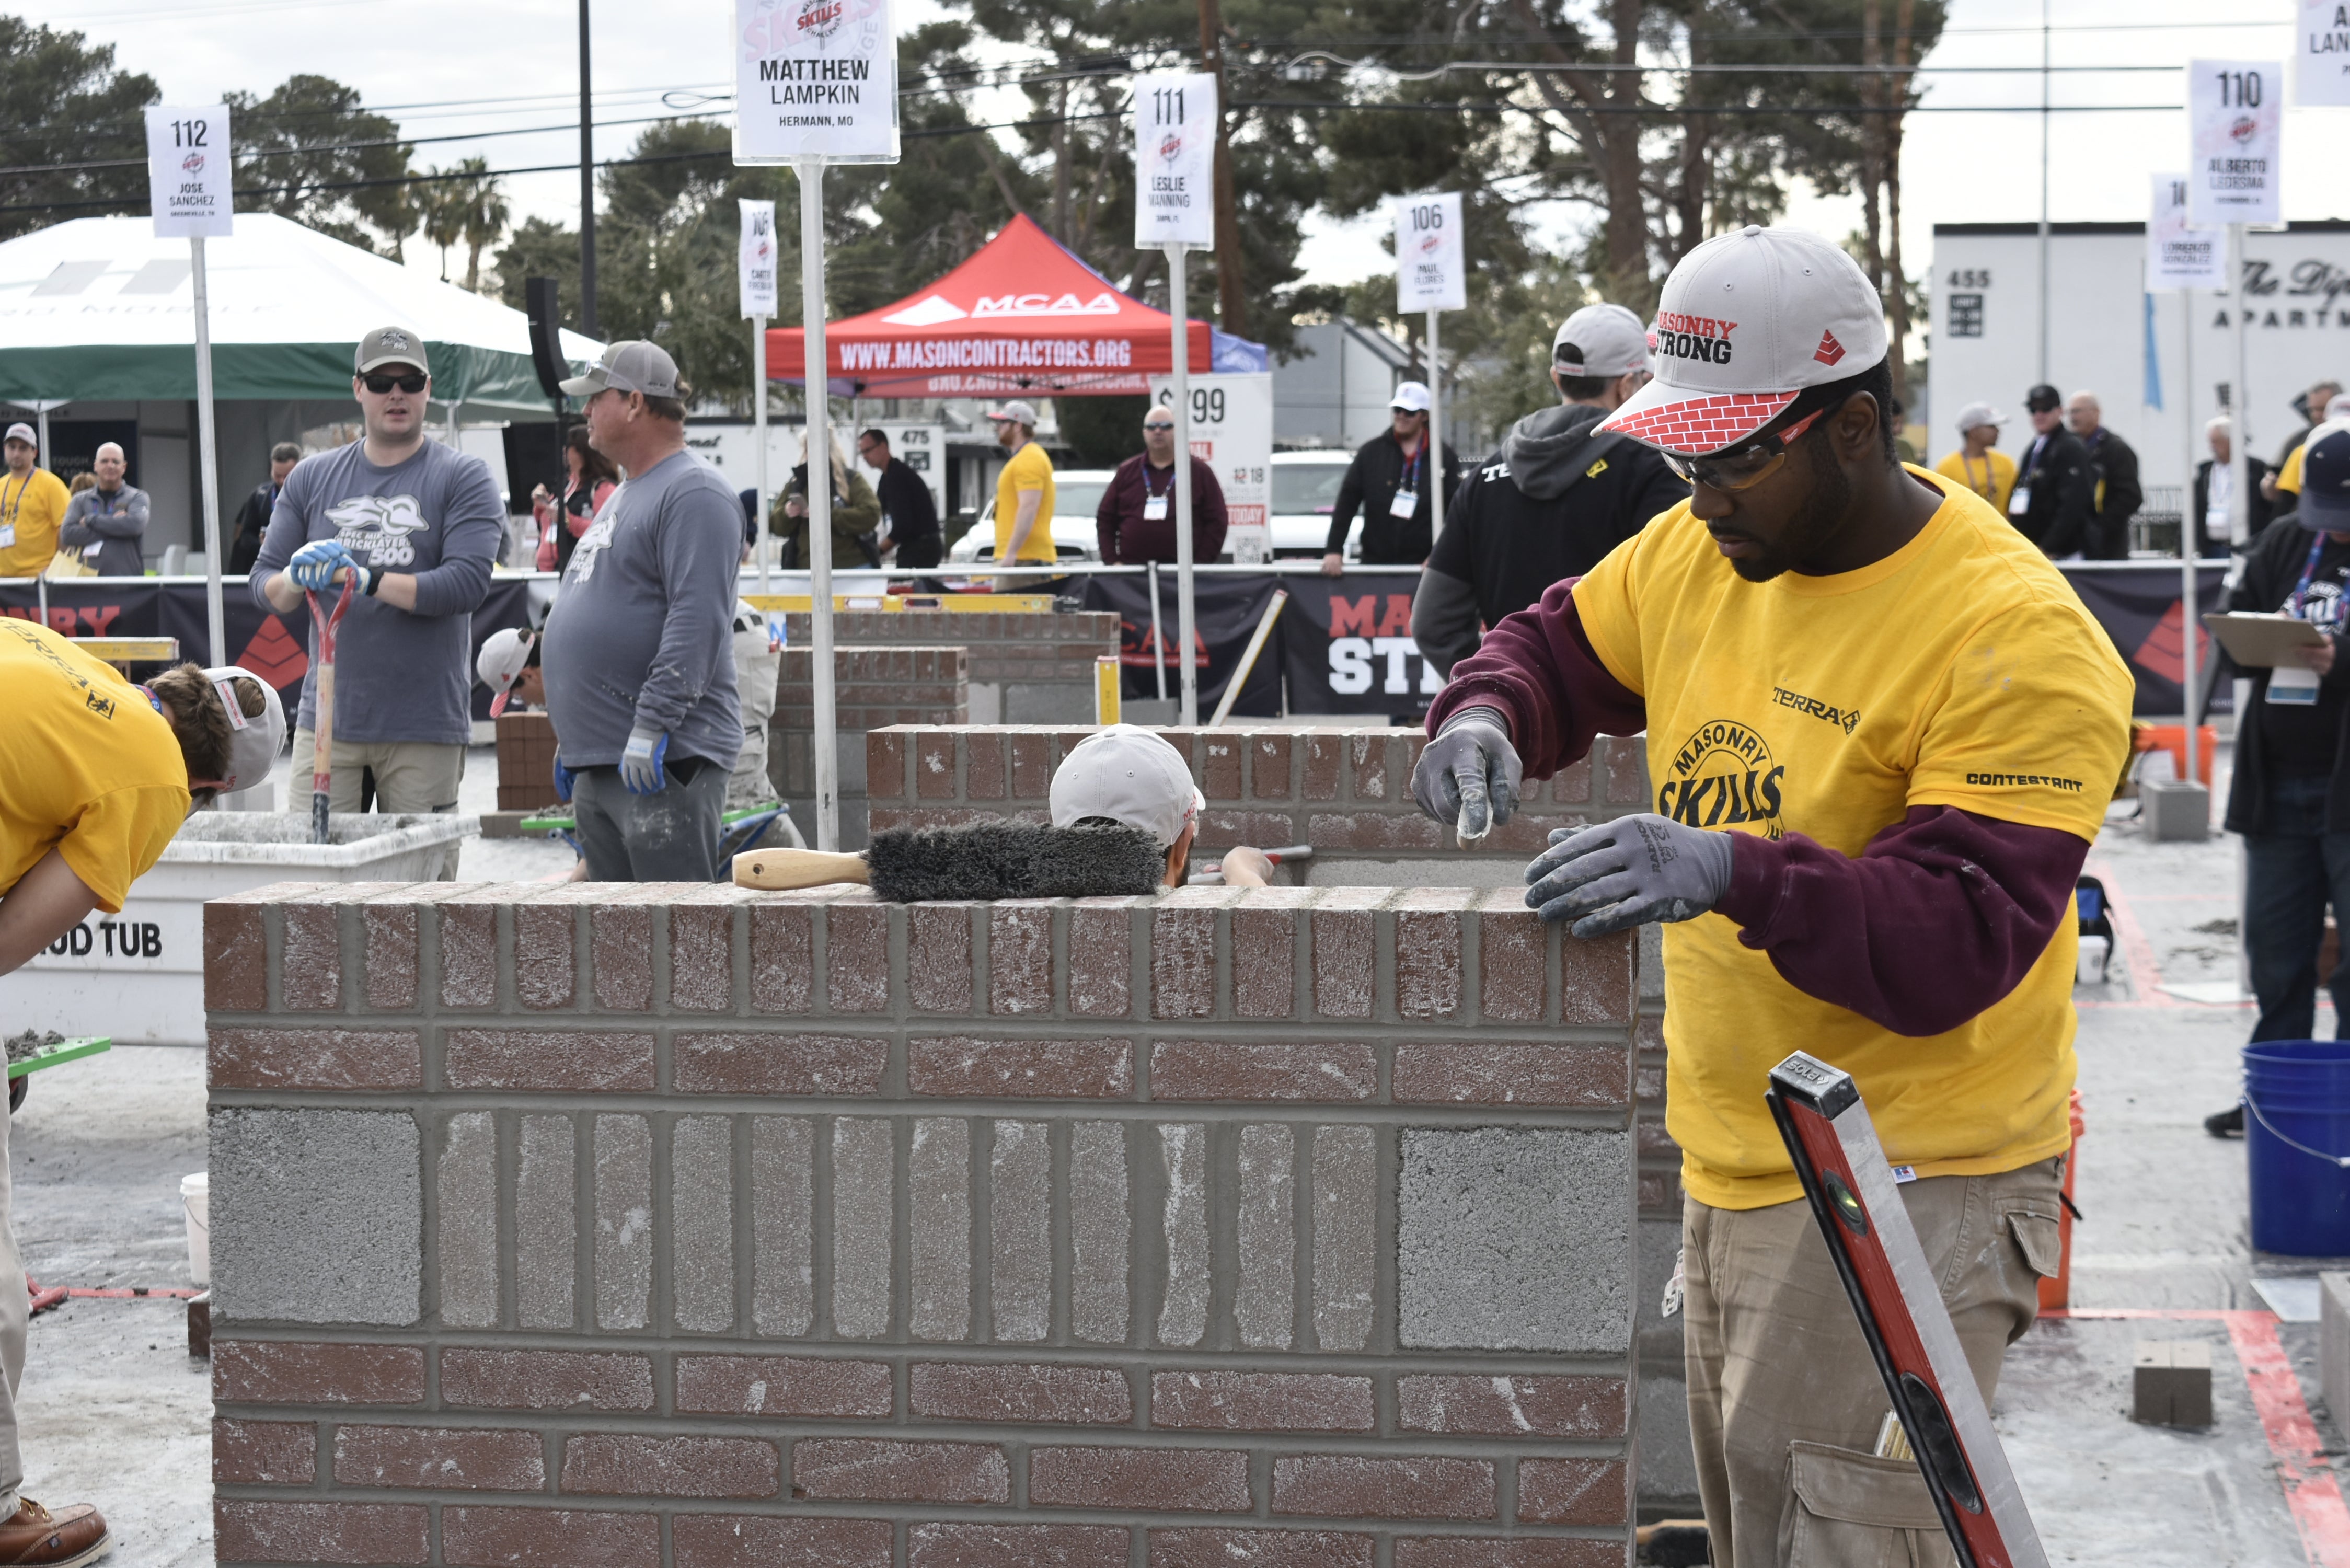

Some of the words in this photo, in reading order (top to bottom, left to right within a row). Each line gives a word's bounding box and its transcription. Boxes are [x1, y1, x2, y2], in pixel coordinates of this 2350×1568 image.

[797, 2, 842, 30] SKILLS
[807, 18, 840, 38] CHALLENGE
[760, 60, 869, 81] MATTHEW
[771, 85, 860, 105] LAMPKIN
[2217, 71, 2262, 109] 110
[1153, 88, 1184, 125] 111
[779, 116, 835, 127] HERMANN,
[838, 116, 853, 126] MO
[171, 120, 208, 147] 112
[2207, 159, 2267, 174] ALBERTO
[180, 183, 203, 194] JOSE
[1151, 177, 1184, 191] LESLIE
[170, 196, 214, 206] SANCHEZ
[1148, 194, 1190, 208] MANNING
[1411, 204, 1443, 231] 106
[1946, 269, 1990, 289] 455
[974, 292, 1119, 312] MCAA
[1658, 310, 1738, 340] MASONRY
[839, 339, 1131, 370] WWW.MASONCONTRACTORS.ORG
[901, 430, 929, 445] 475
[340, 531, 363, 539] SPEC
[369, 545, 414, 567] 500
[1772, 686, 1841, 726] TERRA
[1674, 724, 1767, 777] MASONRY
[1966, 773, 2083, 793] CONTESTANT
[1658, 765, 1785, 828] SKILLS
[40, 922, 93, 956] UD
[99, 922, 163, 958] TUB
